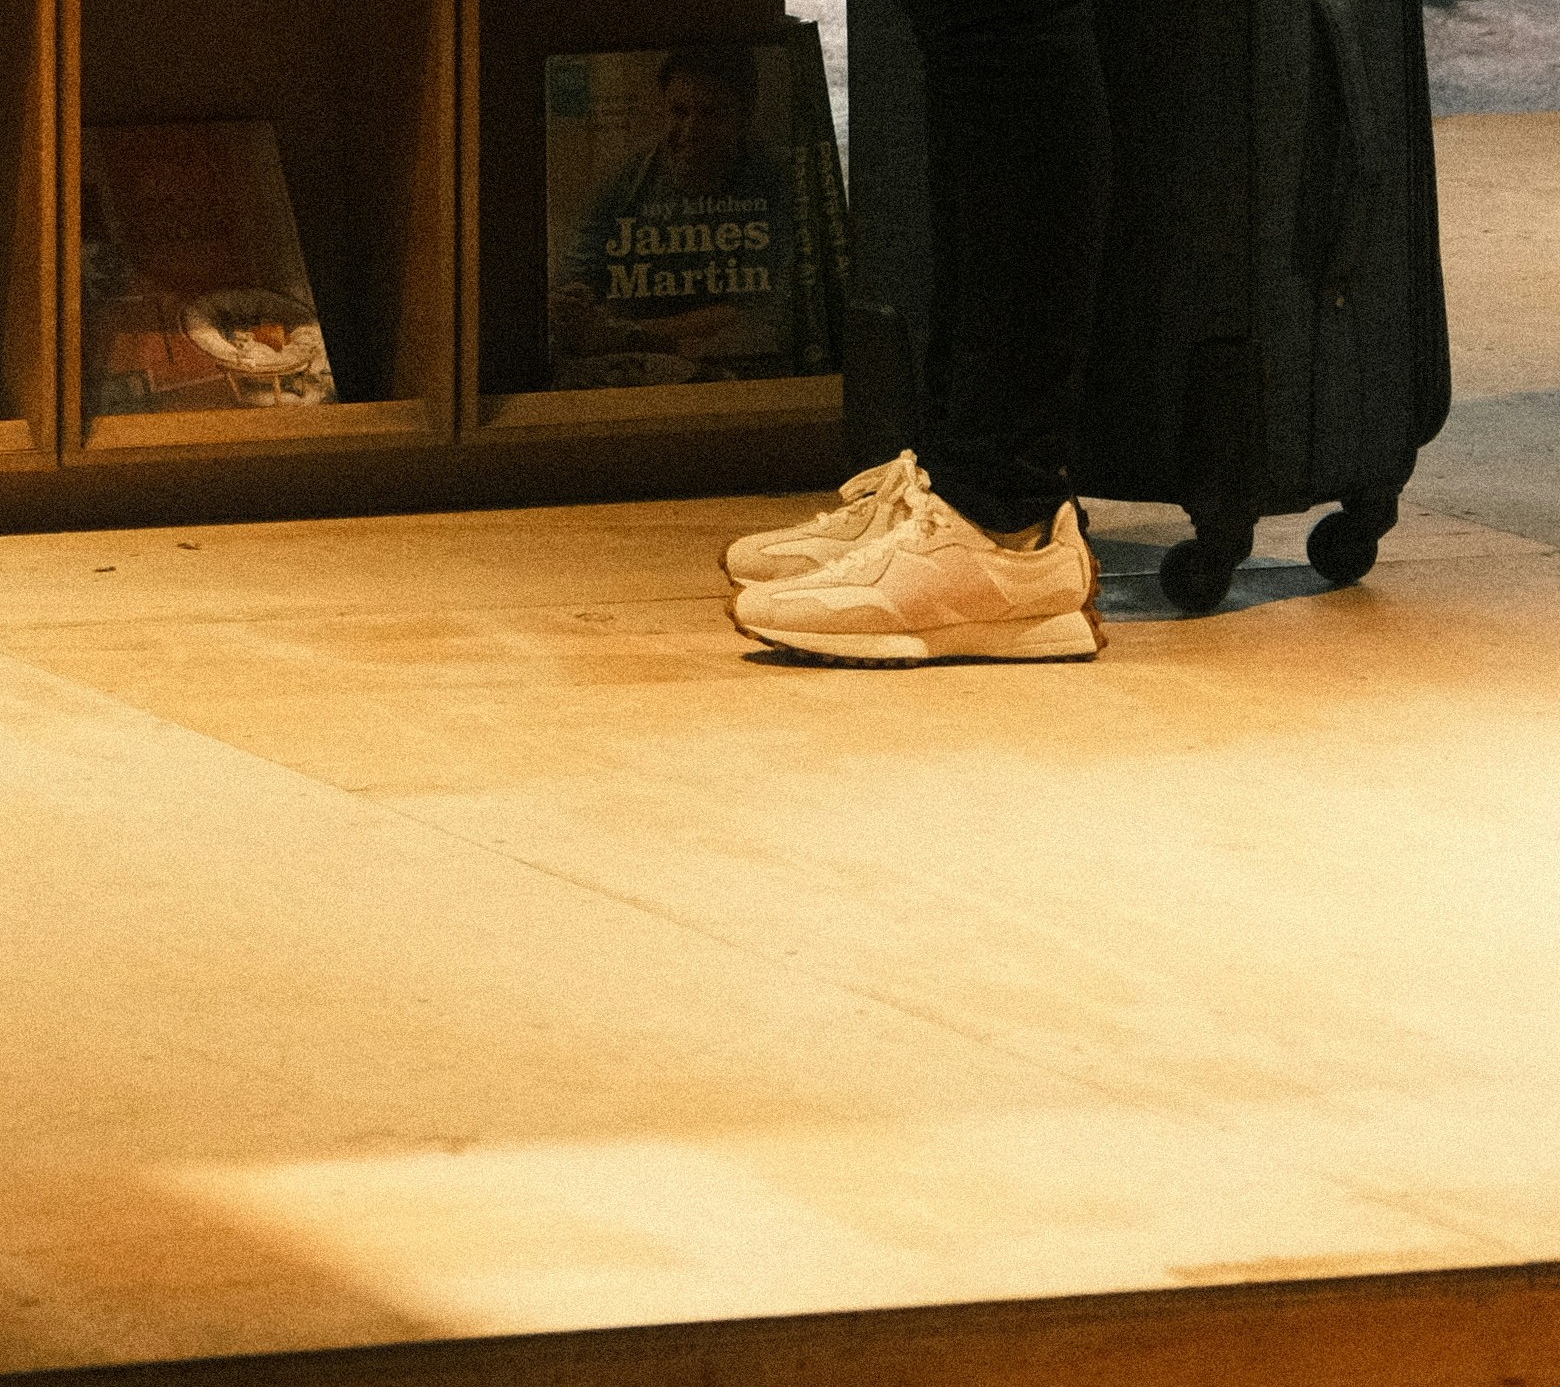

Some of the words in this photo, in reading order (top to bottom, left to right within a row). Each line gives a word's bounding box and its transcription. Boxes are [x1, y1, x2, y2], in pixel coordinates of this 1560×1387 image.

[682, 196, 769, 215] kitchen
[605, 217, 772, 258] James
[606, 257, 773, 300] Martin
